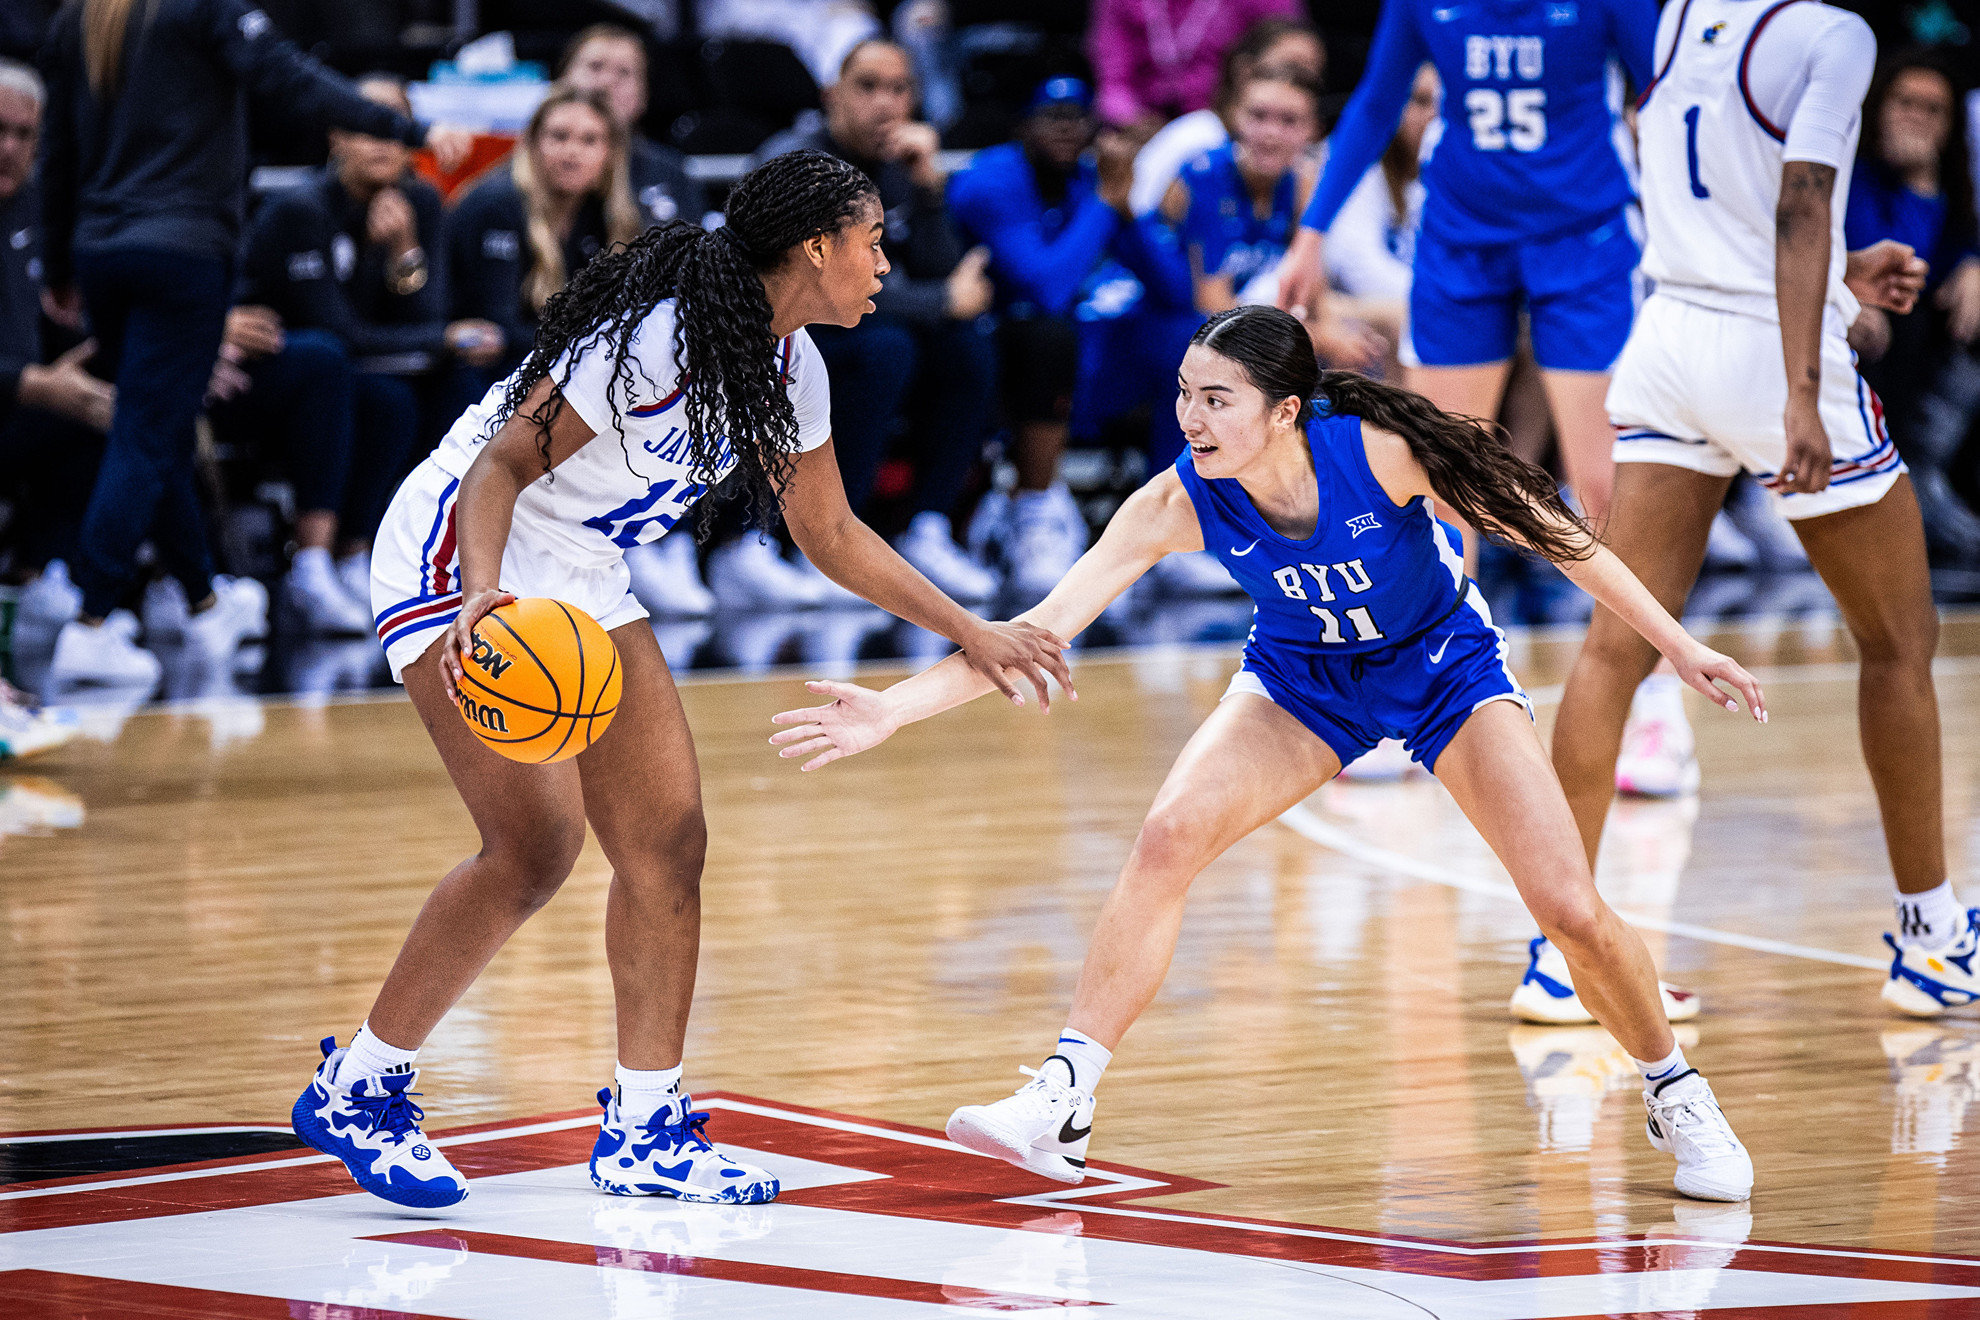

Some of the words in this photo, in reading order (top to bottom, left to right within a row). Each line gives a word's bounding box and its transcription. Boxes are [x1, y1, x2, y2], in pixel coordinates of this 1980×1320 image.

[1465, 35, 1544, 80] BYU
[1465, 88, 1547, 151] 25
[1684, 105, 1710, 199] 1
[1272, 557, 1374, 602] BYU
[1307, 604, 1387, 644] 11
[470, 630, 514, 681] NCA
